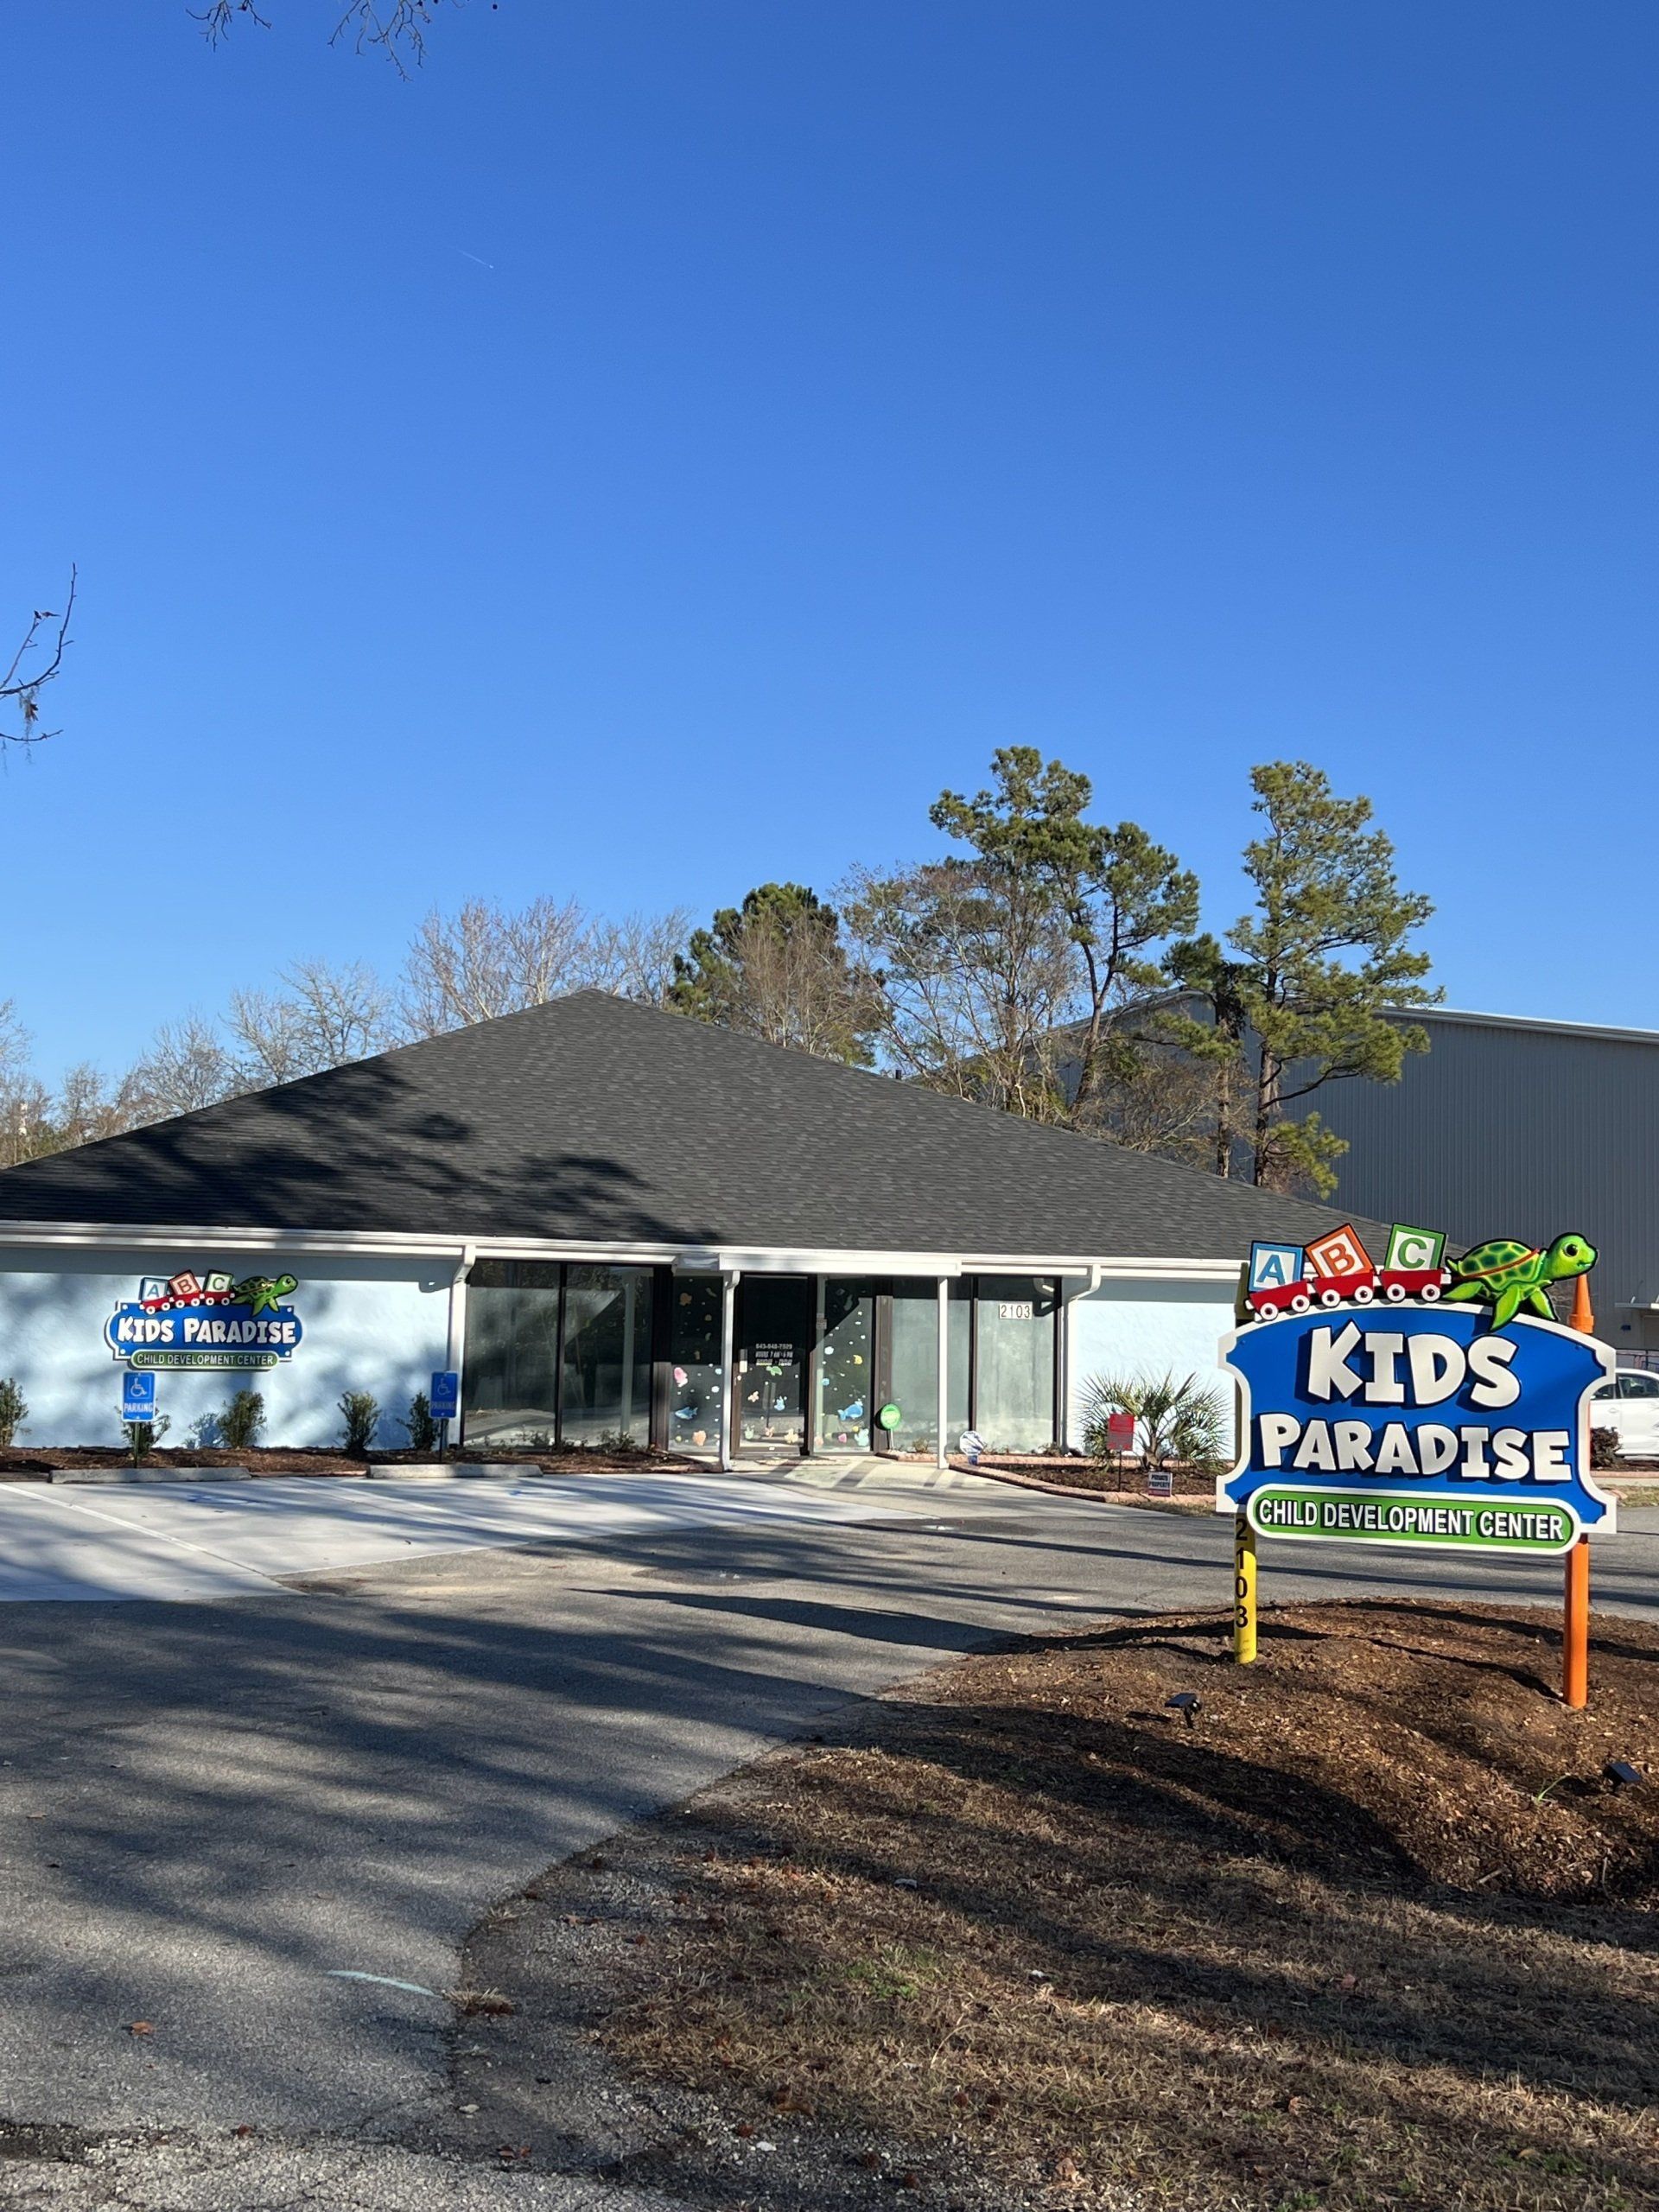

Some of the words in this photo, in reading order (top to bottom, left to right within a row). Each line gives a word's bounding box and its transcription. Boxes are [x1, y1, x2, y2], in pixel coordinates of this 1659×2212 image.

[1256, 1254, 1290, 1286] A
[1325, 1242, 1356, 1272] B
[1396, 1237, 1427, 1269] C
[147, 1283, 161, 1297] A
[177, 1279, 192, 1294] B
[213, 1276, 226, 1291] C
[1001, 1305, 1030, 1318] 2103
[118, 1316, 175, 1343] KIDS
[184, 1318, 296, 1344] PARADISE
[137, 1353, 164, 1363] CHILD
[168, 1354, 235, 1365] DEVELOPMENT
[238, 1356, 274, 1365] CENTER
[1307, 1320, 1522, 1408] KIDS
[124, 1402, 153, 1413] PARKING
[1259, 1413, 1573, 1481] PARADISE
[1259, 1499, 1318, 1527] CHILD
[1325, 1503, 1474, 1535] DEVELOPMENT
[1479, 1511, 1564, 1541] CENTER
[1235, 1518, 1249, 1628] 2103
